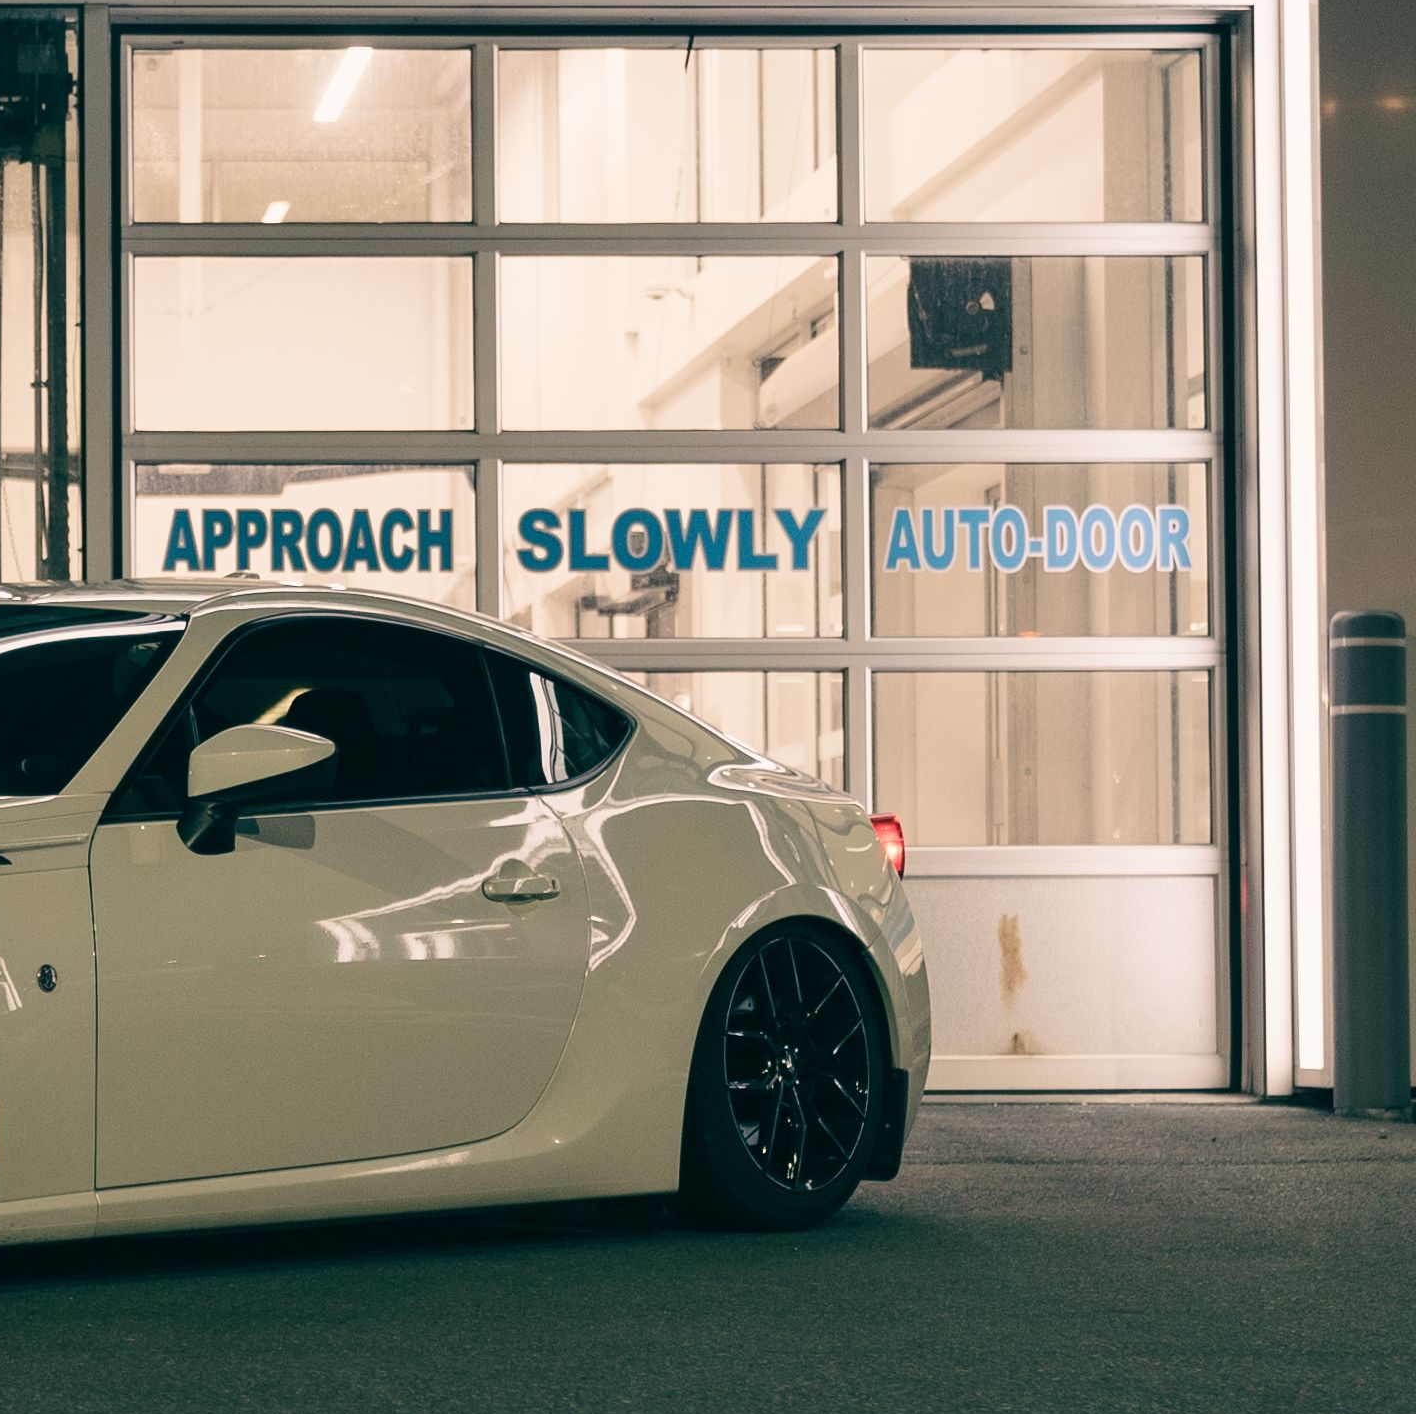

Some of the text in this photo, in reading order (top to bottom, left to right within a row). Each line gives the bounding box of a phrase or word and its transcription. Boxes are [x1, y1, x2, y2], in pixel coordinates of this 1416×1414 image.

[163, 506, 1193, 572] APPROACH SLOWLY AUTO-DOOR
